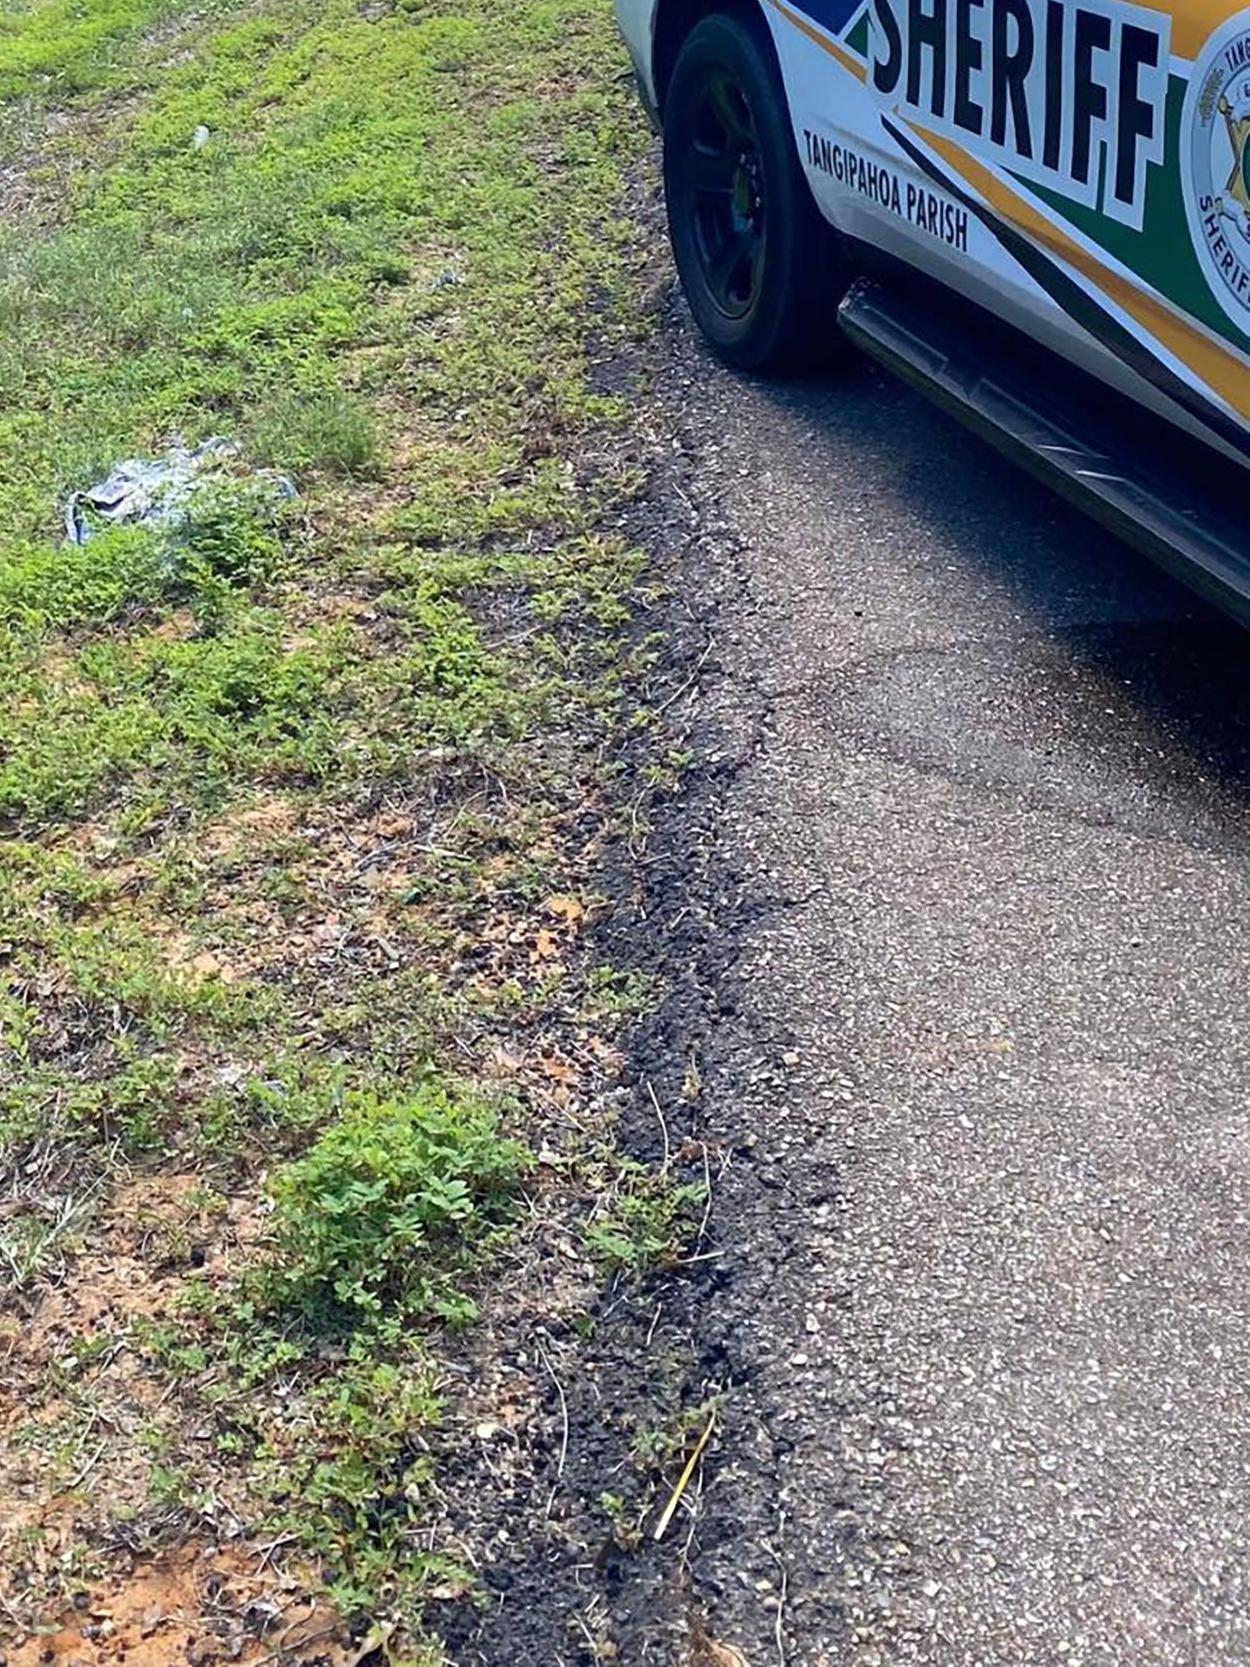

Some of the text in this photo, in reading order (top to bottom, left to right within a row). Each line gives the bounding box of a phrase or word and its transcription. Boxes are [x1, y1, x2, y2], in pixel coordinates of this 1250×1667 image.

[803, 129, 967, 252] TANGIPAHOA PARISH
[1199, 195, 1250, 303] SHERIF
